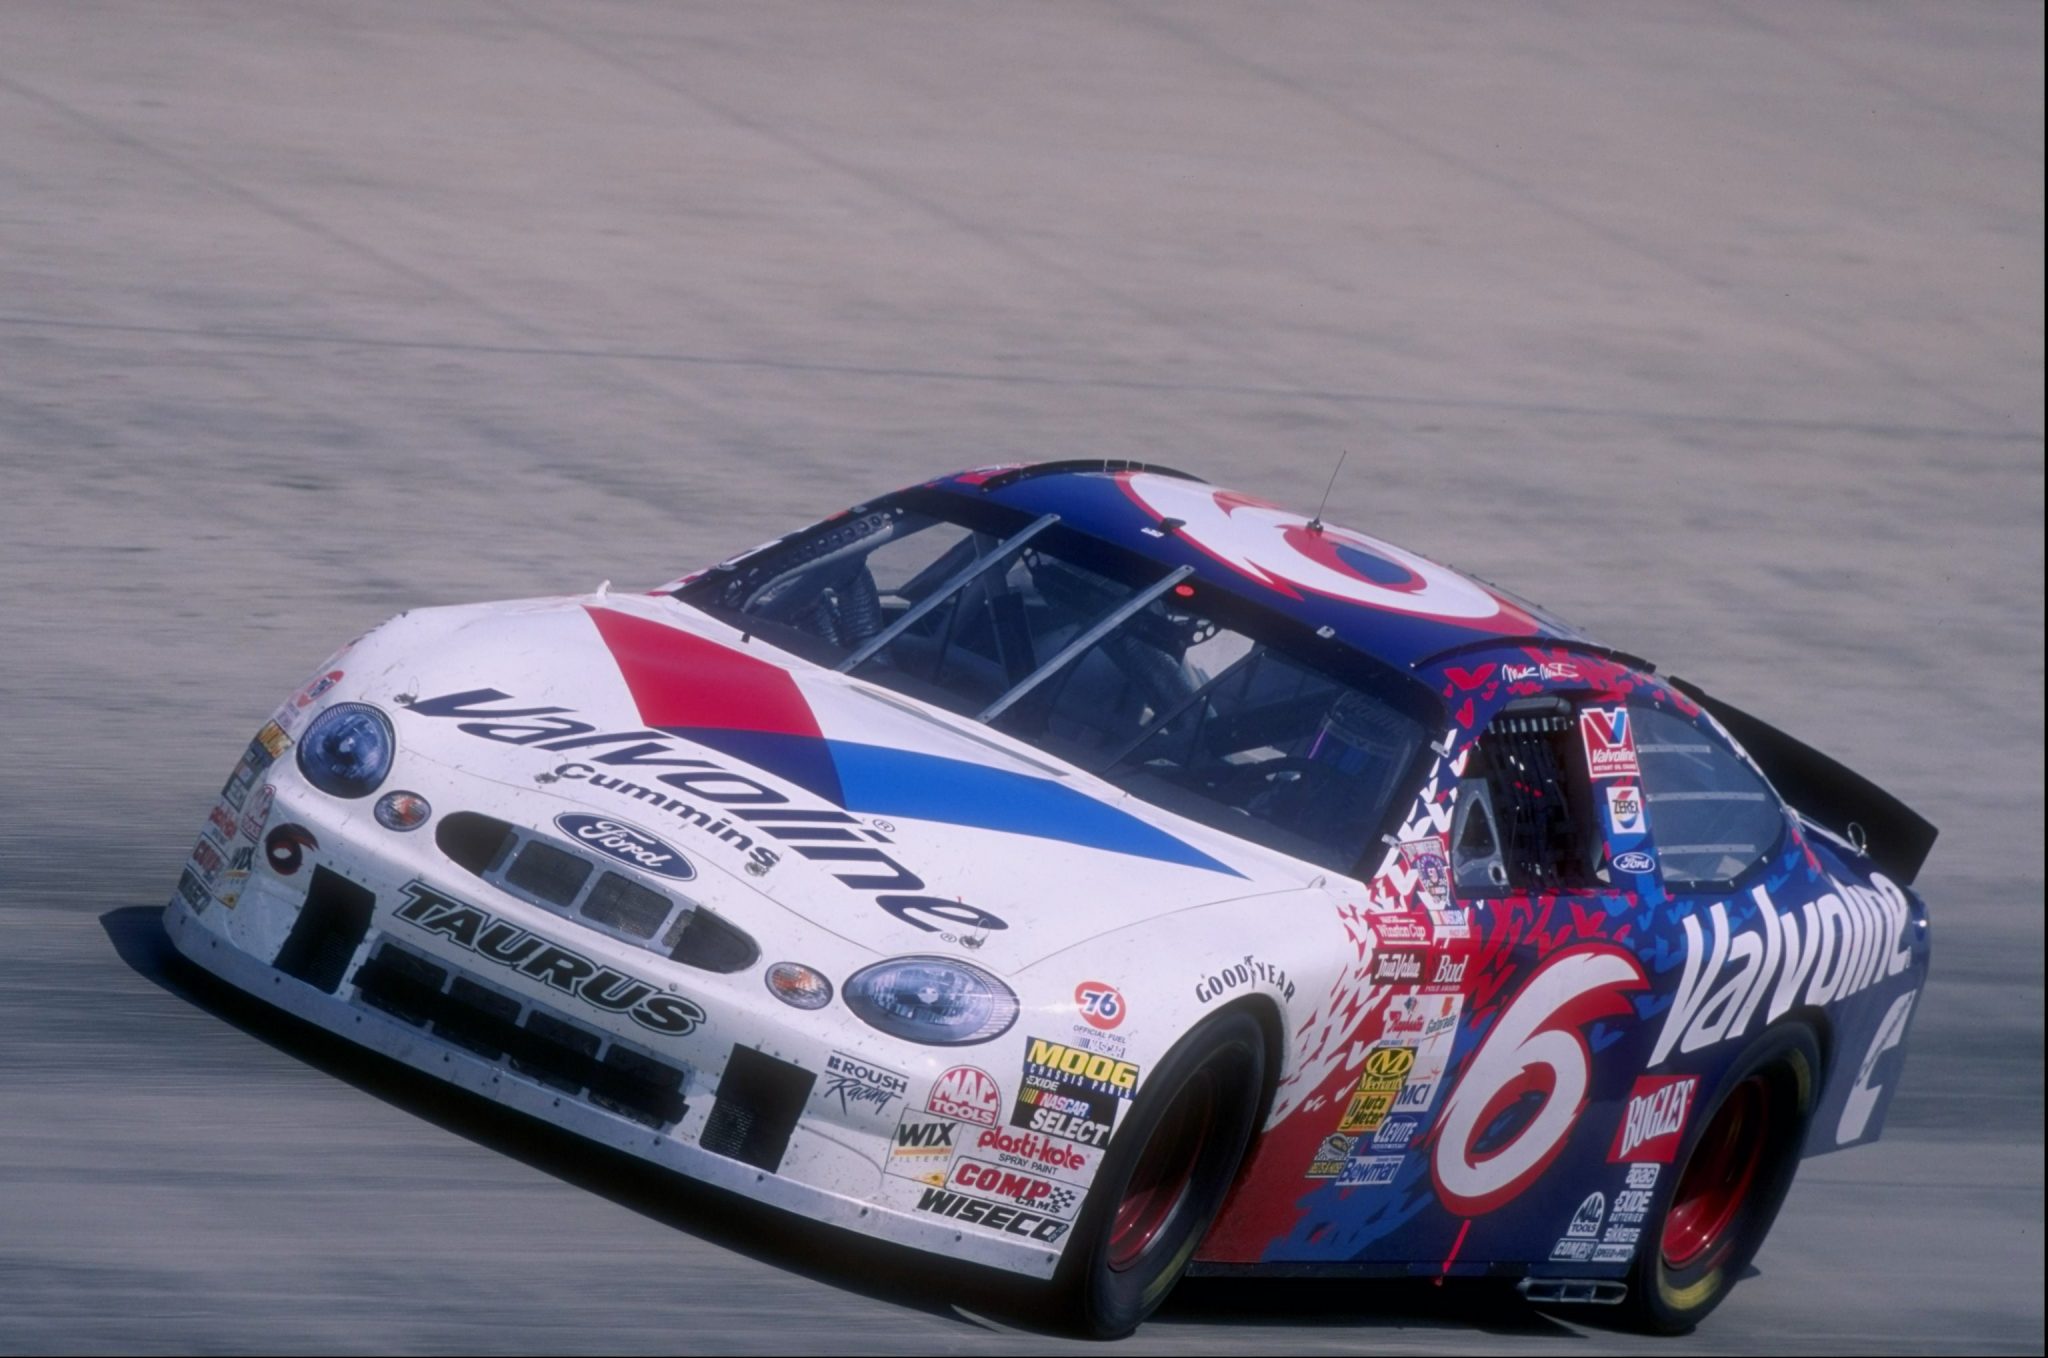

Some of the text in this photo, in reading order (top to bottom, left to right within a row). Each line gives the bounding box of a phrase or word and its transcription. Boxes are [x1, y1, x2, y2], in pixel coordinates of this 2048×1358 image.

[1592, 748, 1635, 763] Valvoline
[402, 687, 1009, 933] Valvoline
[554, 763, 780, 868] Cummins
[1612, 800, 1640, 815] ZEREX
[265, 823, 319, 876] 6
[577, 819, 673, 868] Ford
[1619, 853, 1650, 870] Ford
[1376, 924, 1426, 941] Winston Cup
[394, 879, 707, 1037] TAURUS
[1433, 954, 1470, 983] Bud
[1646, 871, 1910, 1069] Valvoline
[1195, 954, 1296, 1004] GOODYEAR
[1082, 990, 1118, 1018] 76
[1073, 1025, 1127, 1044] OFFICIAL FUEL
[842, 1058, 908, 1094] ROUSH
[1027, 1039, 1140, 1089] MOOG
[1435, 946, 1648, 1206] 6
[934, 1069, 998, 1111] MAC
[1026, 1075, 1061, 1092] EXIDE
[1029, 1063, 1132, 1099] CHASSIS PARTS
[1397, 1083, 1431, 1106] MCI
[824, 1077, 895, 1117] Racing
[1040, 1091, 1090, 1117] NASCAR
[932, 1101, 994, 1124] TOOLS
[1029, 1108, 1110, 1146] SELECT
[1618, 1077, 1697, 1159] BUGLES
[898, 1122, 958, 1147] WIX
[977, 1126, 1086, 1171] plasti-kote
[890, 1155, 949, 1163] FILTERS
[998, 1153, 1058, 1176] SPRAY PAINT
[1340, 1157, 1400, 1183] Bowman
[955, 1163, 1052, 1201] COMP
[916, 1188, 1069, 1243] WISECO
[1015, 1195, 1062, 1214] CAMS
[1613, 1190, 1653, 1213] EXIDE
[1570, 1223, 1598, 1234] TOOLS
[1608, 1212, 1645, 1223] BATTERIES
